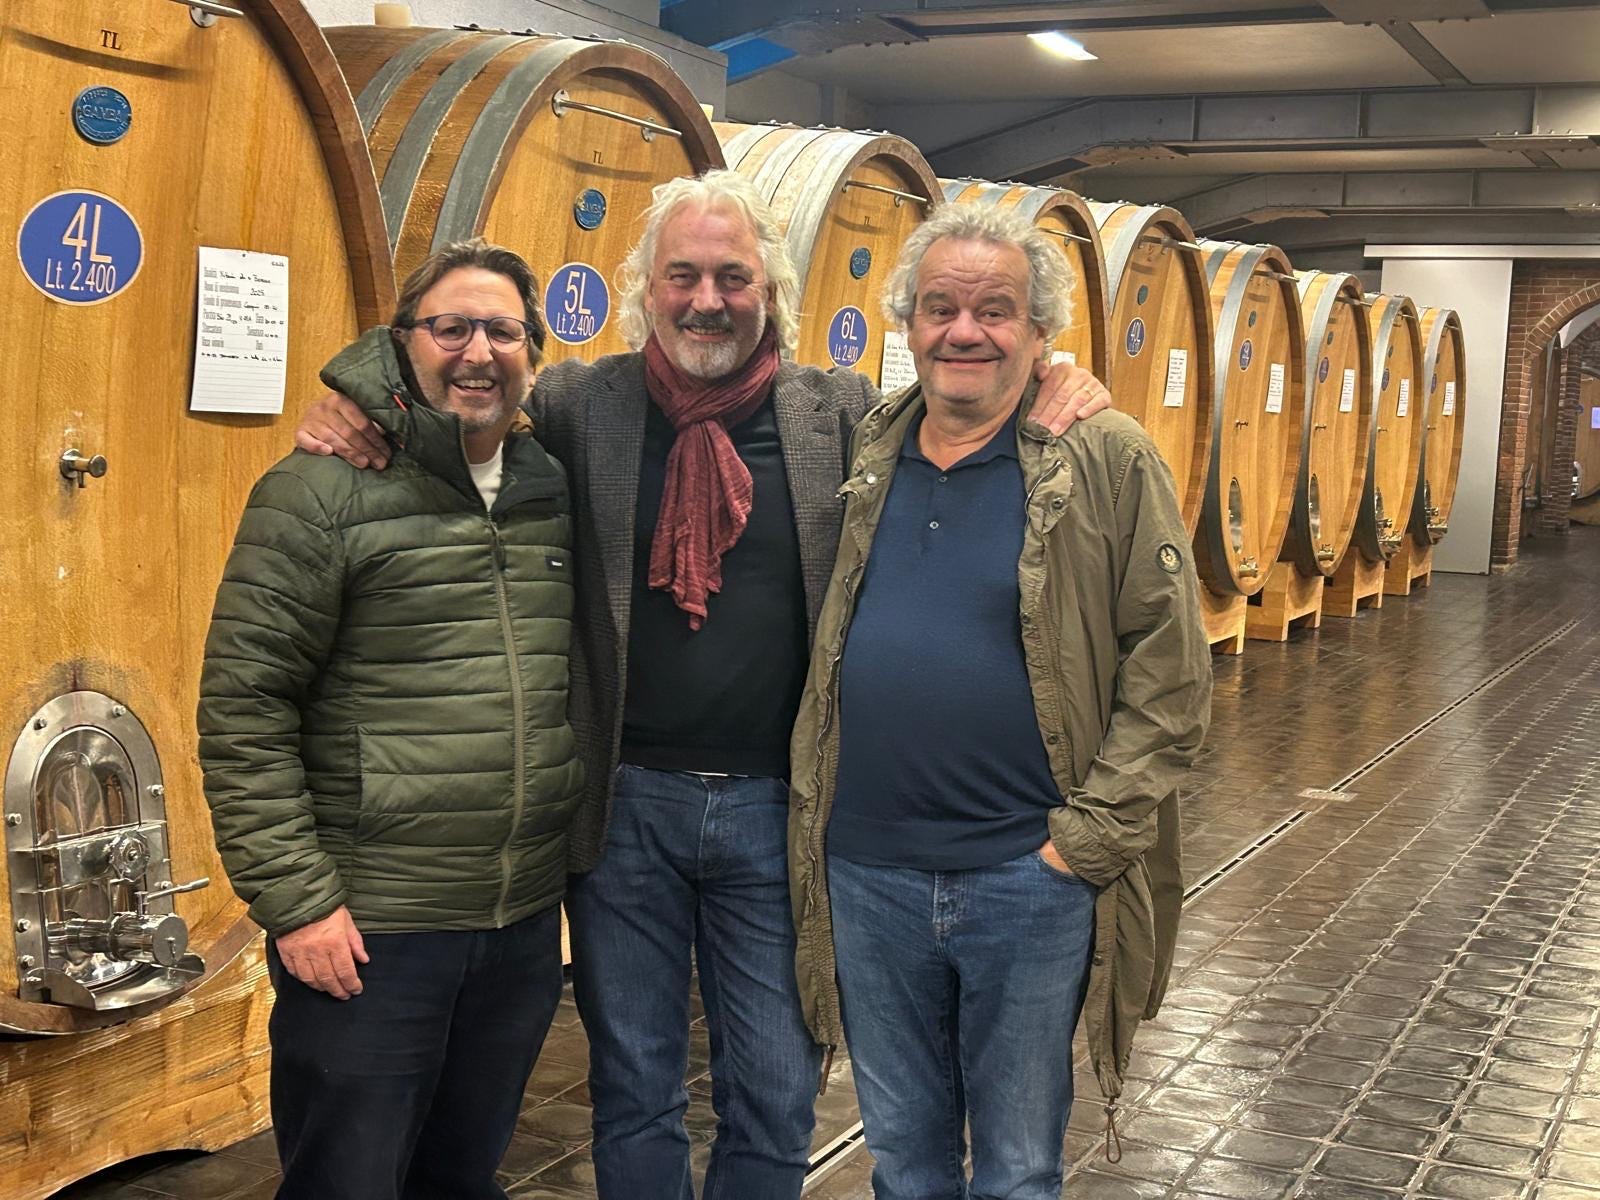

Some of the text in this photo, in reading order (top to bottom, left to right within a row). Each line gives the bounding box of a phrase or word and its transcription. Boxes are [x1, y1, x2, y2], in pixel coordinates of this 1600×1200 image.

[101, 29, 121, 51] TL
[62, 202, 113, 263] 4L
[69, 261, 117, 294] 2.400
[564, 270, 592, 315] 5L
[568, 313, 595, 337] 2.400
[841, 311, 858, 341] 6L
